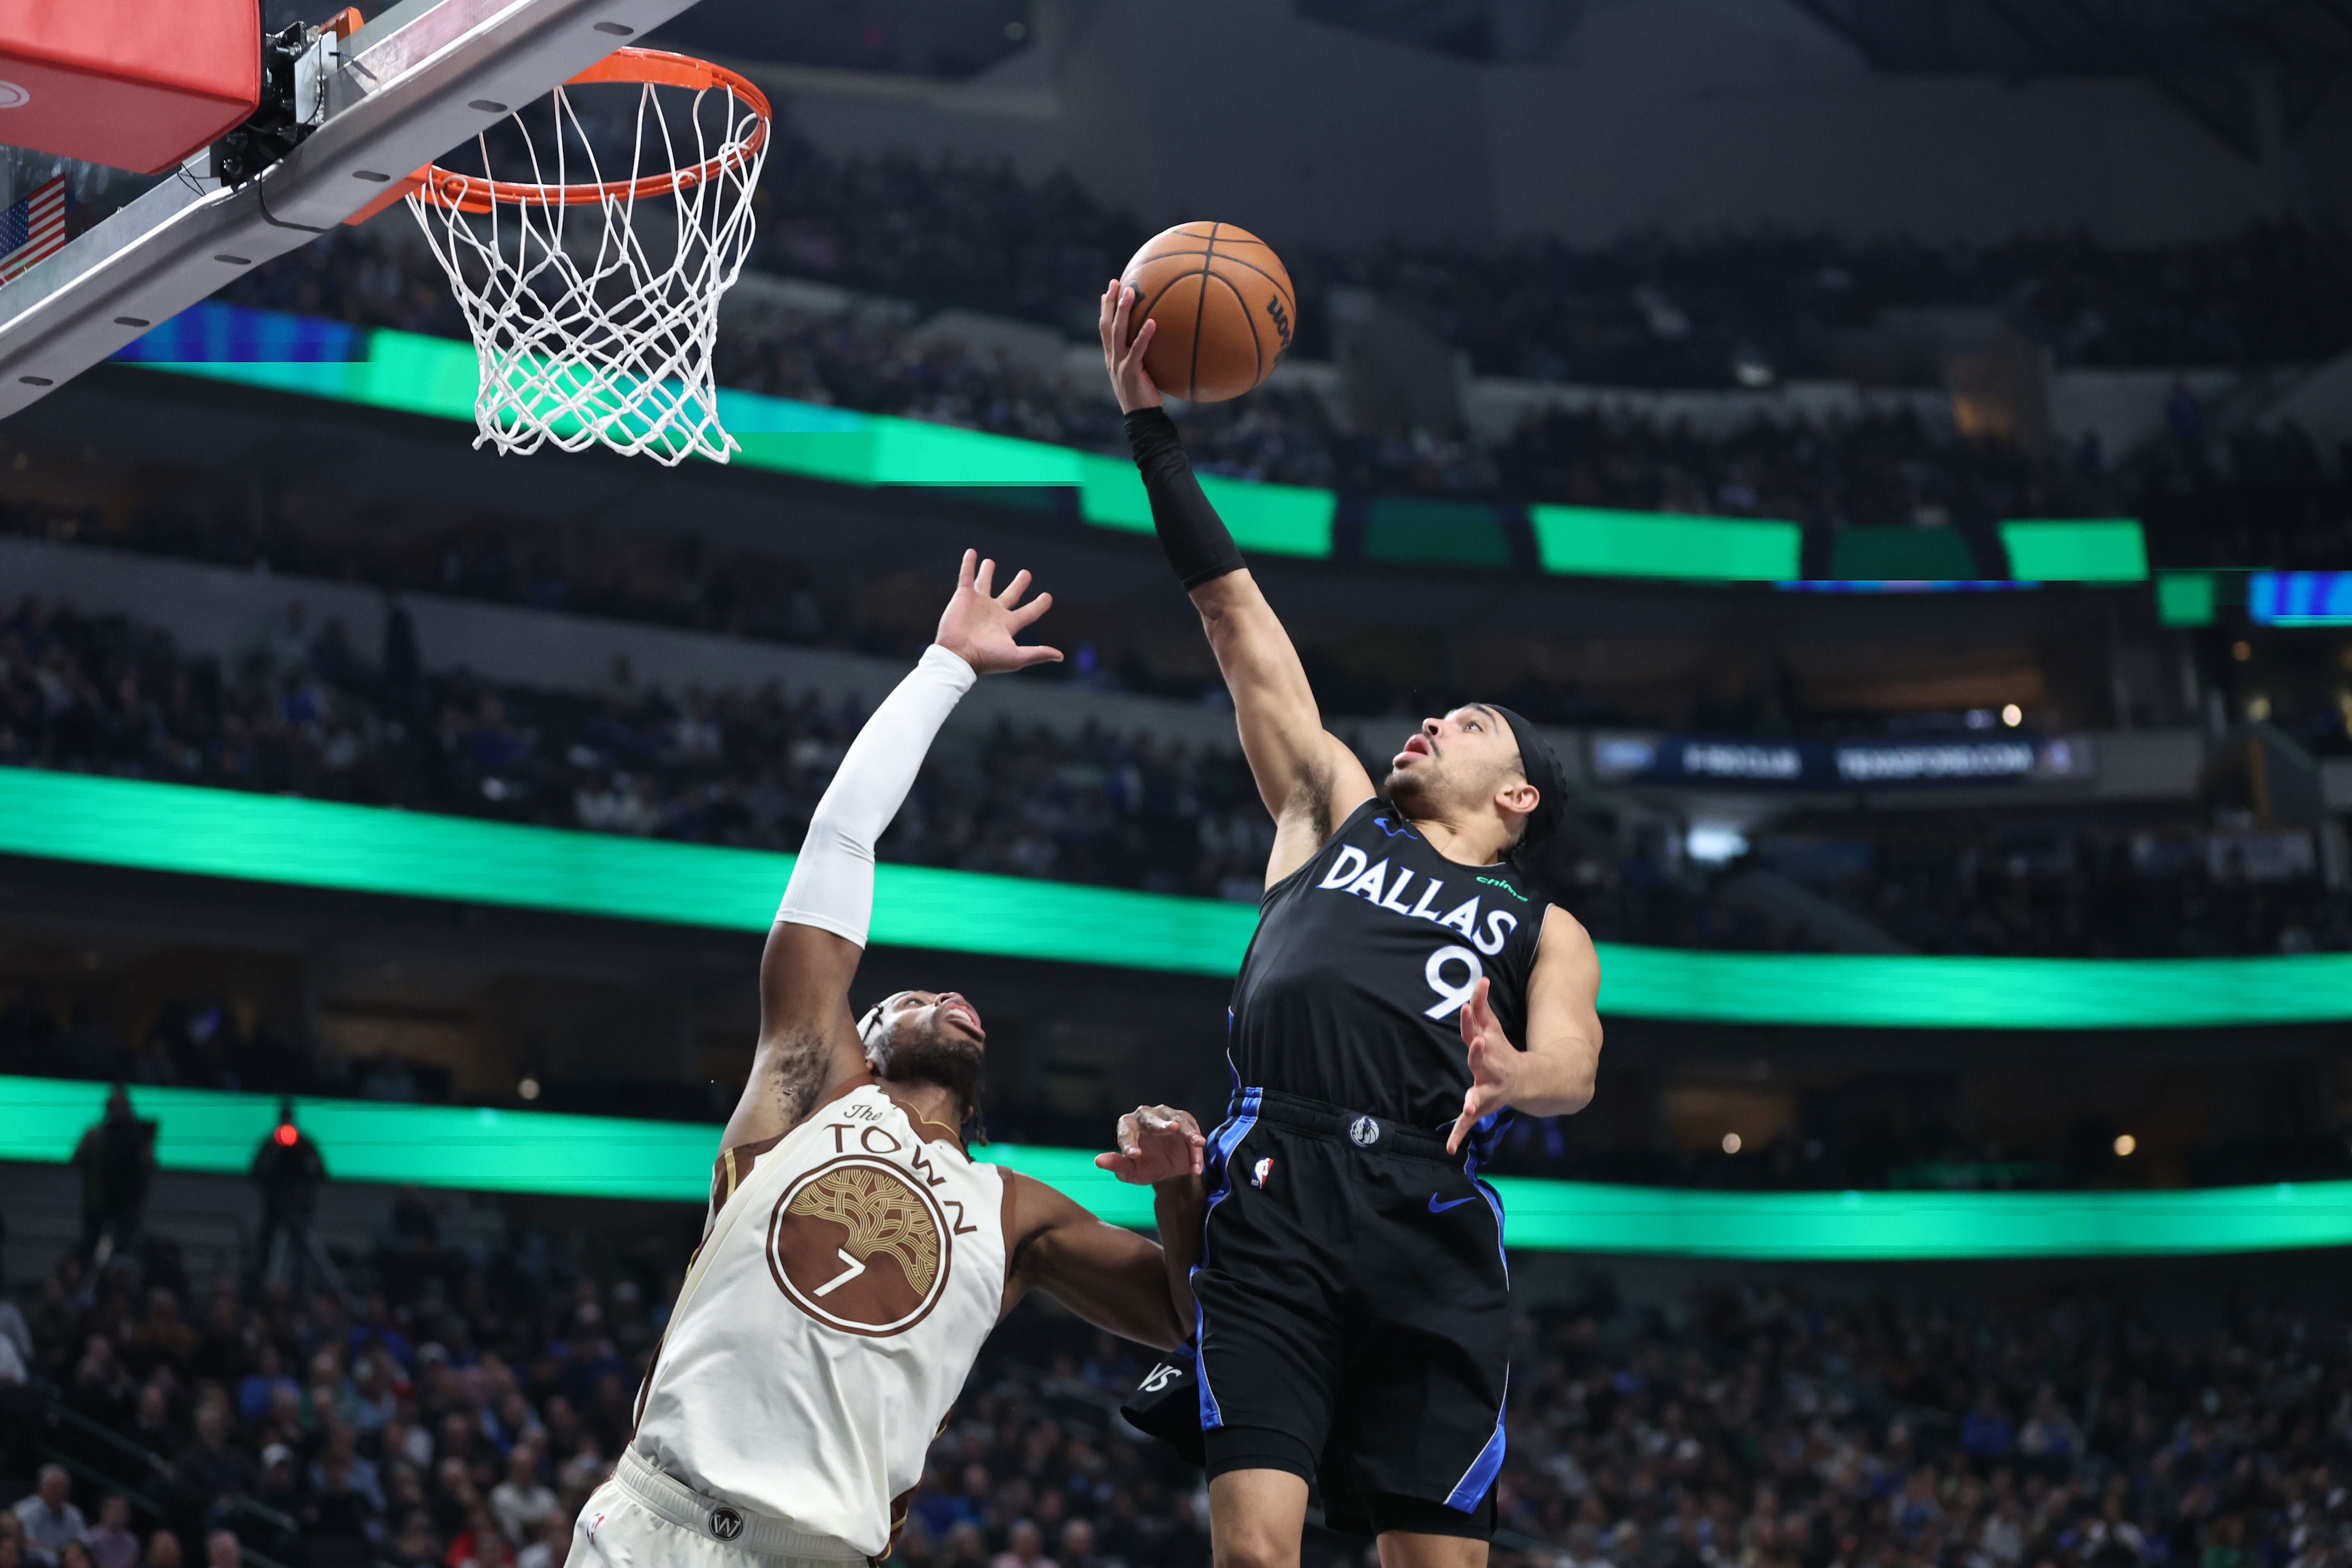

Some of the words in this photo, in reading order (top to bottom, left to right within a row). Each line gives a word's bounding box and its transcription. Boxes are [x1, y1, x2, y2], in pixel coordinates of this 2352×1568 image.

[1316, 844, 1518, 955] DALLAS
[1423, 945, 1484, 1020] 9
[844, 1105, 883, 1121] The
[824, 1124, 977, 1235] TOWN
[813, 1248, 866, 1297] 7
[714, 1513, 741, 1537] W
